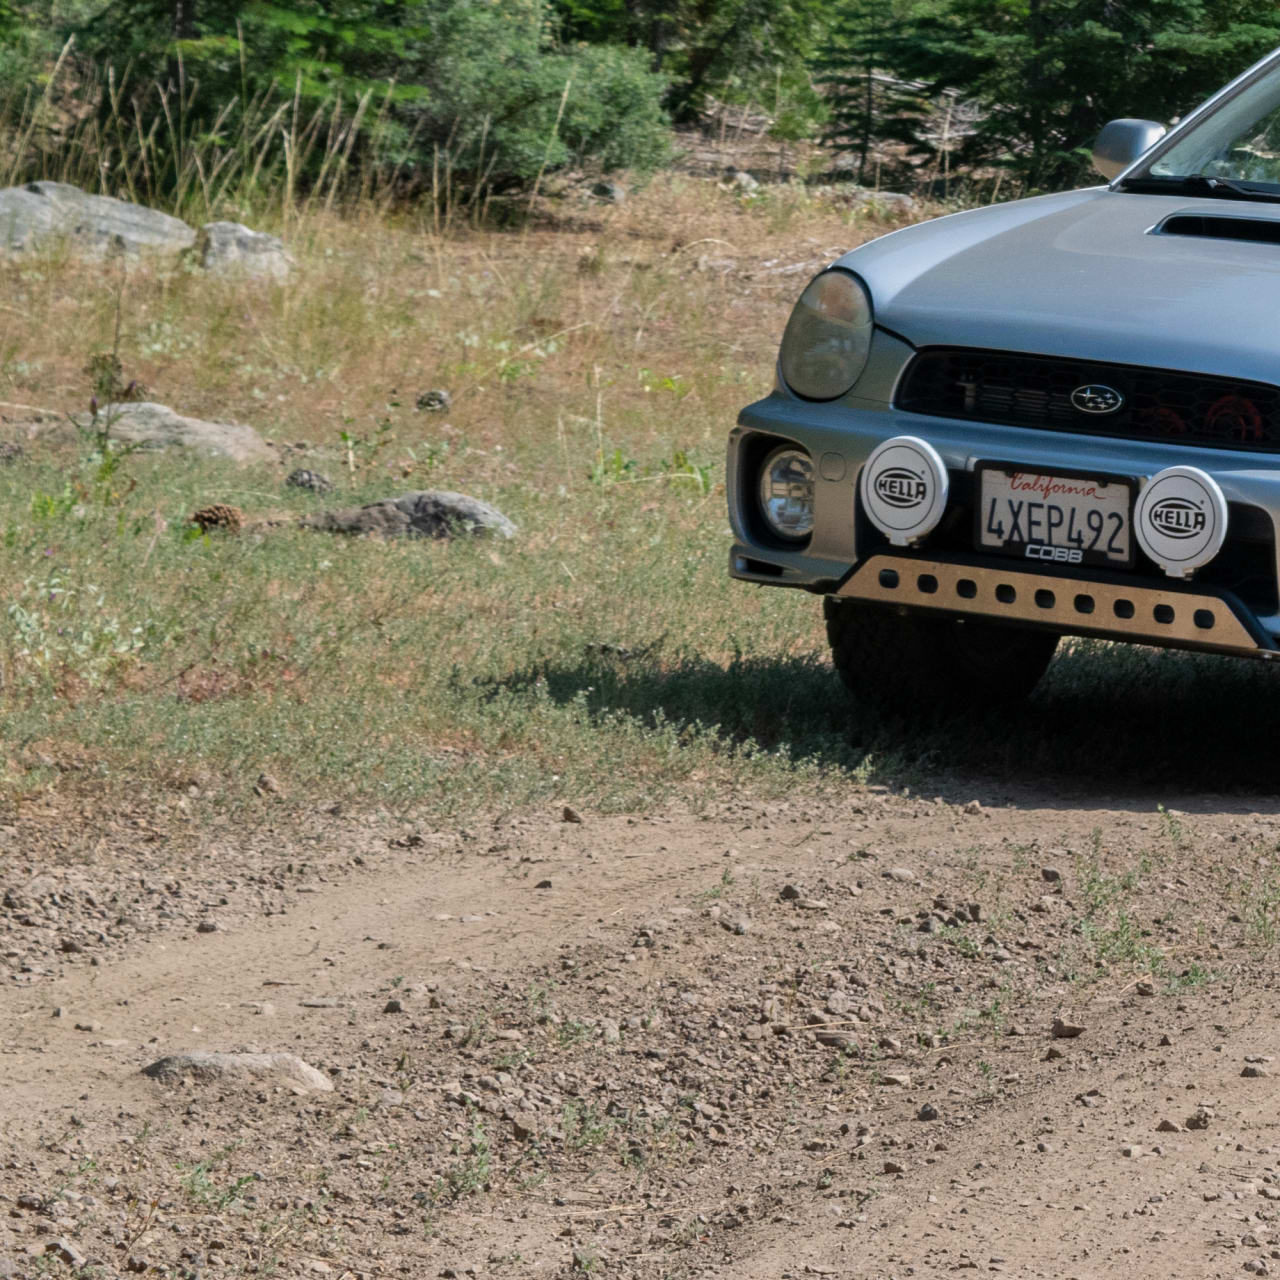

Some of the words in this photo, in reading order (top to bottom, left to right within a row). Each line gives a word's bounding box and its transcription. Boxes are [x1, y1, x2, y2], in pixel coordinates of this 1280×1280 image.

[878, 479, 927, 501] HELLA
[1008, 472, 1106, 500] California
[987, 497, 1124, 554] 4XEP492
[1153, 509, 1206, 531] HELLA
[1025, 544, 1083, 563] COBB
